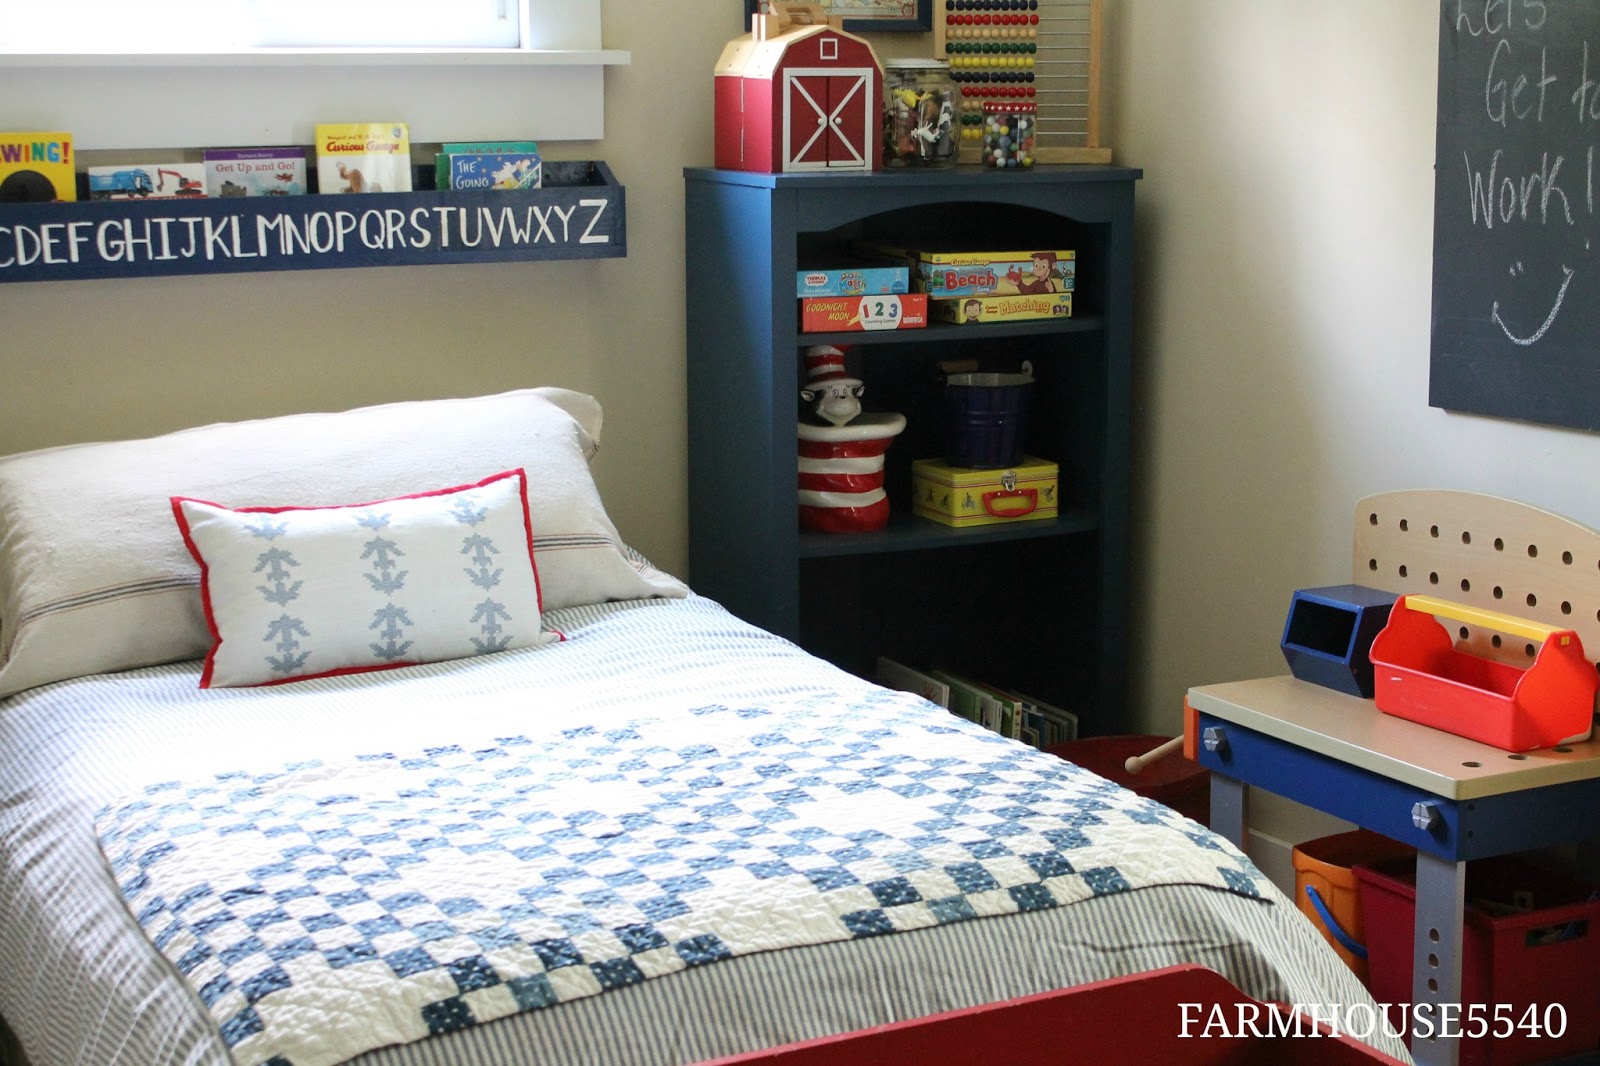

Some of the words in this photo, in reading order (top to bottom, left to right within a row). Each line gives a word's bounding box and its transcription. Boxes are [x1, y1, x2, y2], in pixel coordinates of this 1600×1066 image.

[1485, 39, 1557, 127] Get
[0, 141, 69, 165] WING!
[326, 141, 365, 152] Curious
[366, 140, 399, 154] George
[216, 163, 233, 172] Get
[237, 163, 252, 173] Up
[255, 162, 274, 171] and
[277, 162, 295, 171] Go!
[457, 160, 477, 173] THE
[456, 175, 489, 190] GOING
[945, 269, 996, 290] Beach
[806, 302, 848, 312] GOODNIGHT
[863, 304, 869, 318] 1
[875, 302, 884, 316] 2
[889, 303, 898, 317] 3
[999, 299, 1051, 315] Matching
[828, 312, 850, 320] MOON
